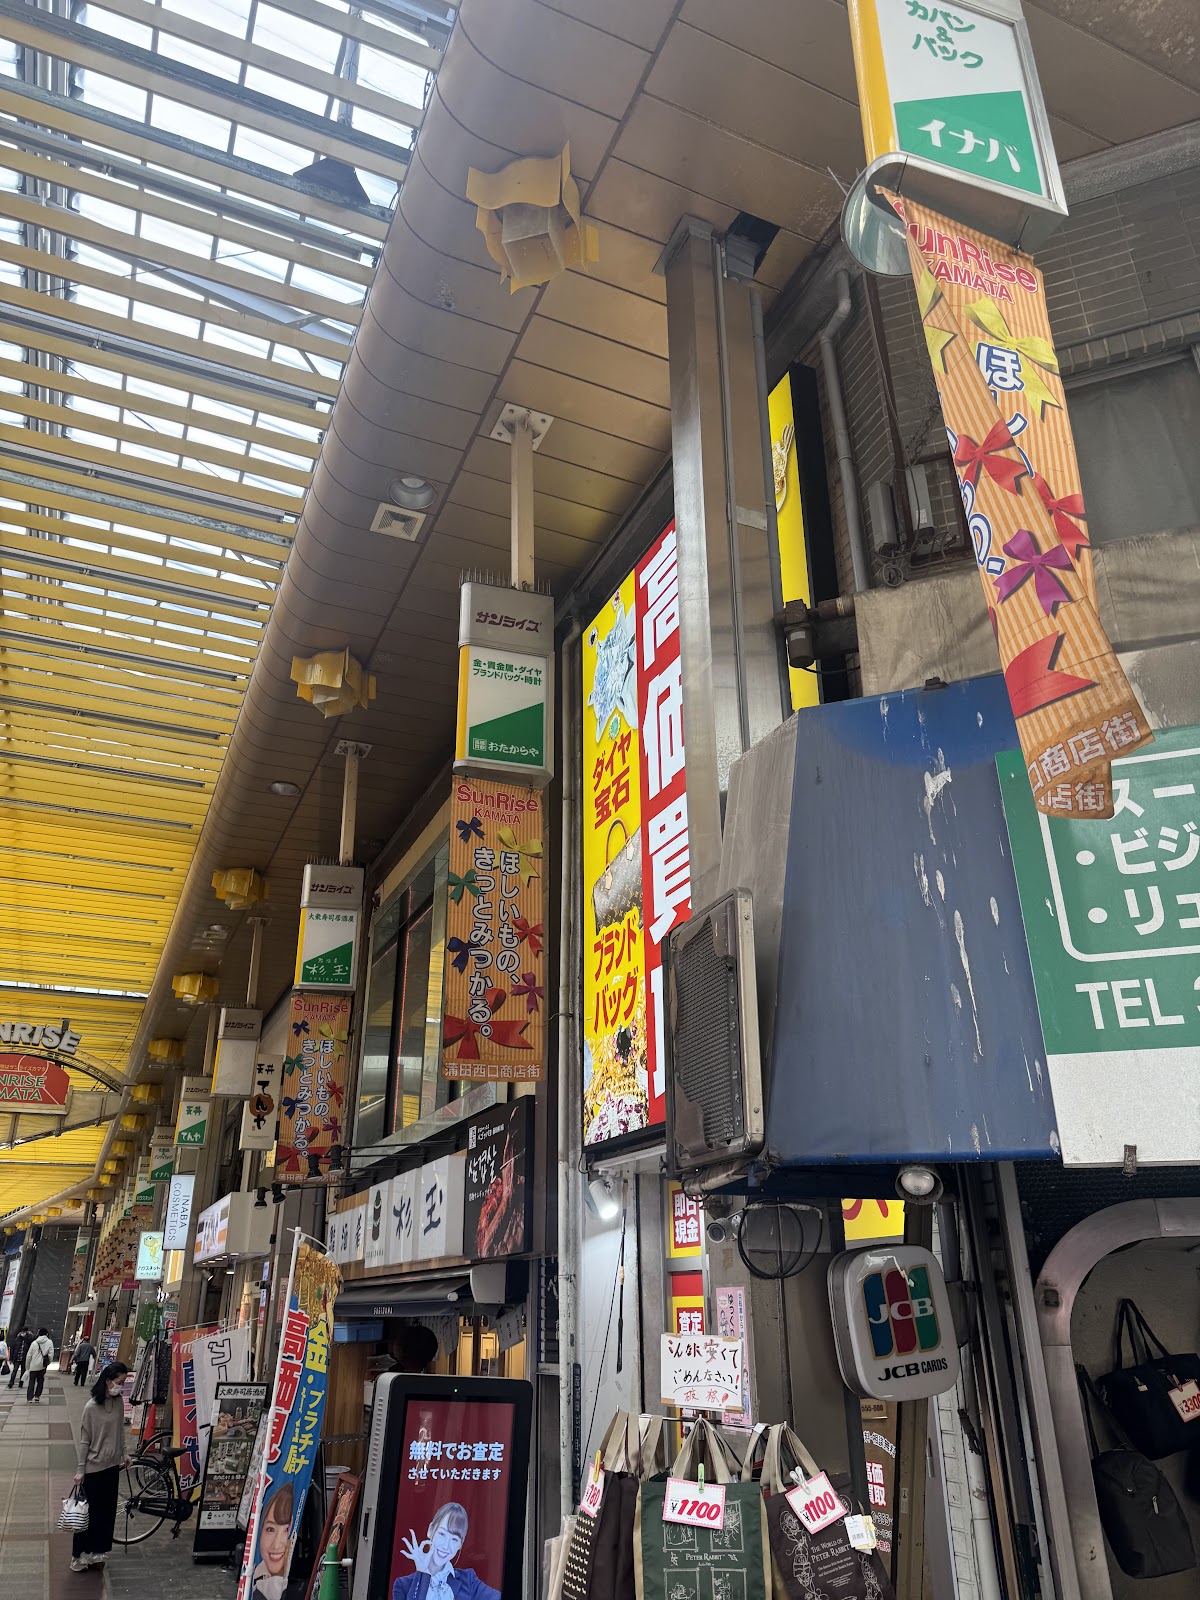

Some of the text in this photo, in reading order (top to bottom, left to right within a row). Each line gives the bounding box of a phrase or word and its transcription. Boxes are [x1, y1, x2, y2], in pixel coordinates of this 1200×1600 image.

[905, 0, 976, 33] カバン
[917, 119, 1021, 174] イナバ
[475, 611, 543, 633] サンライズ
[488, 741, 540, 758] おたからや
[592, 730, 632, 792] ダイヤ
[456, 784, 539, 814] SunRise
[594, 766, 630, 830] 宝石
[473, 806, 522, 826] KAMATA
[496, 850, 522, 985] ほしいもの、
[468, 846, 497, 1039] きっとみつかる。
[593, 912, 638, 983] ブランド
[305, 963, 349, 976] 杉玉
[293, 999, 349, 1015] SunRise
[593, 969, 640, 1034] バッグ
[1075, 978, 1185, 1030] TEL
[304, 1013, 337, 1022] KAMATA
[314, 1039, 335, 1124] ほしいもの、
[444, 1061, 541, 1079] 蒲田西口商店街
[253, 1080, 271, 1130] てんや
[293, 1039, 317, 1158] きっとみつかる。
[181, 1131, 201, 1142] てんや
[167, 1182, 182, 1242] COSMETICS
[179, 1194, 191, 1229] INABA
[675, 1217, 699, 1244] 現金
[678, 1311, 702, 1336] 査定
[868, 1298, 934, 1324] JCB
[878, 1358, 948, 1381] JCB CARDS
[408, 1440, 505, 1462] 無料でお査定
[407, 1467, 502, 1481] させていただきます
[685, 1553, 703, 1561] PETER
[811, 1551, 831, 1563] PETER
